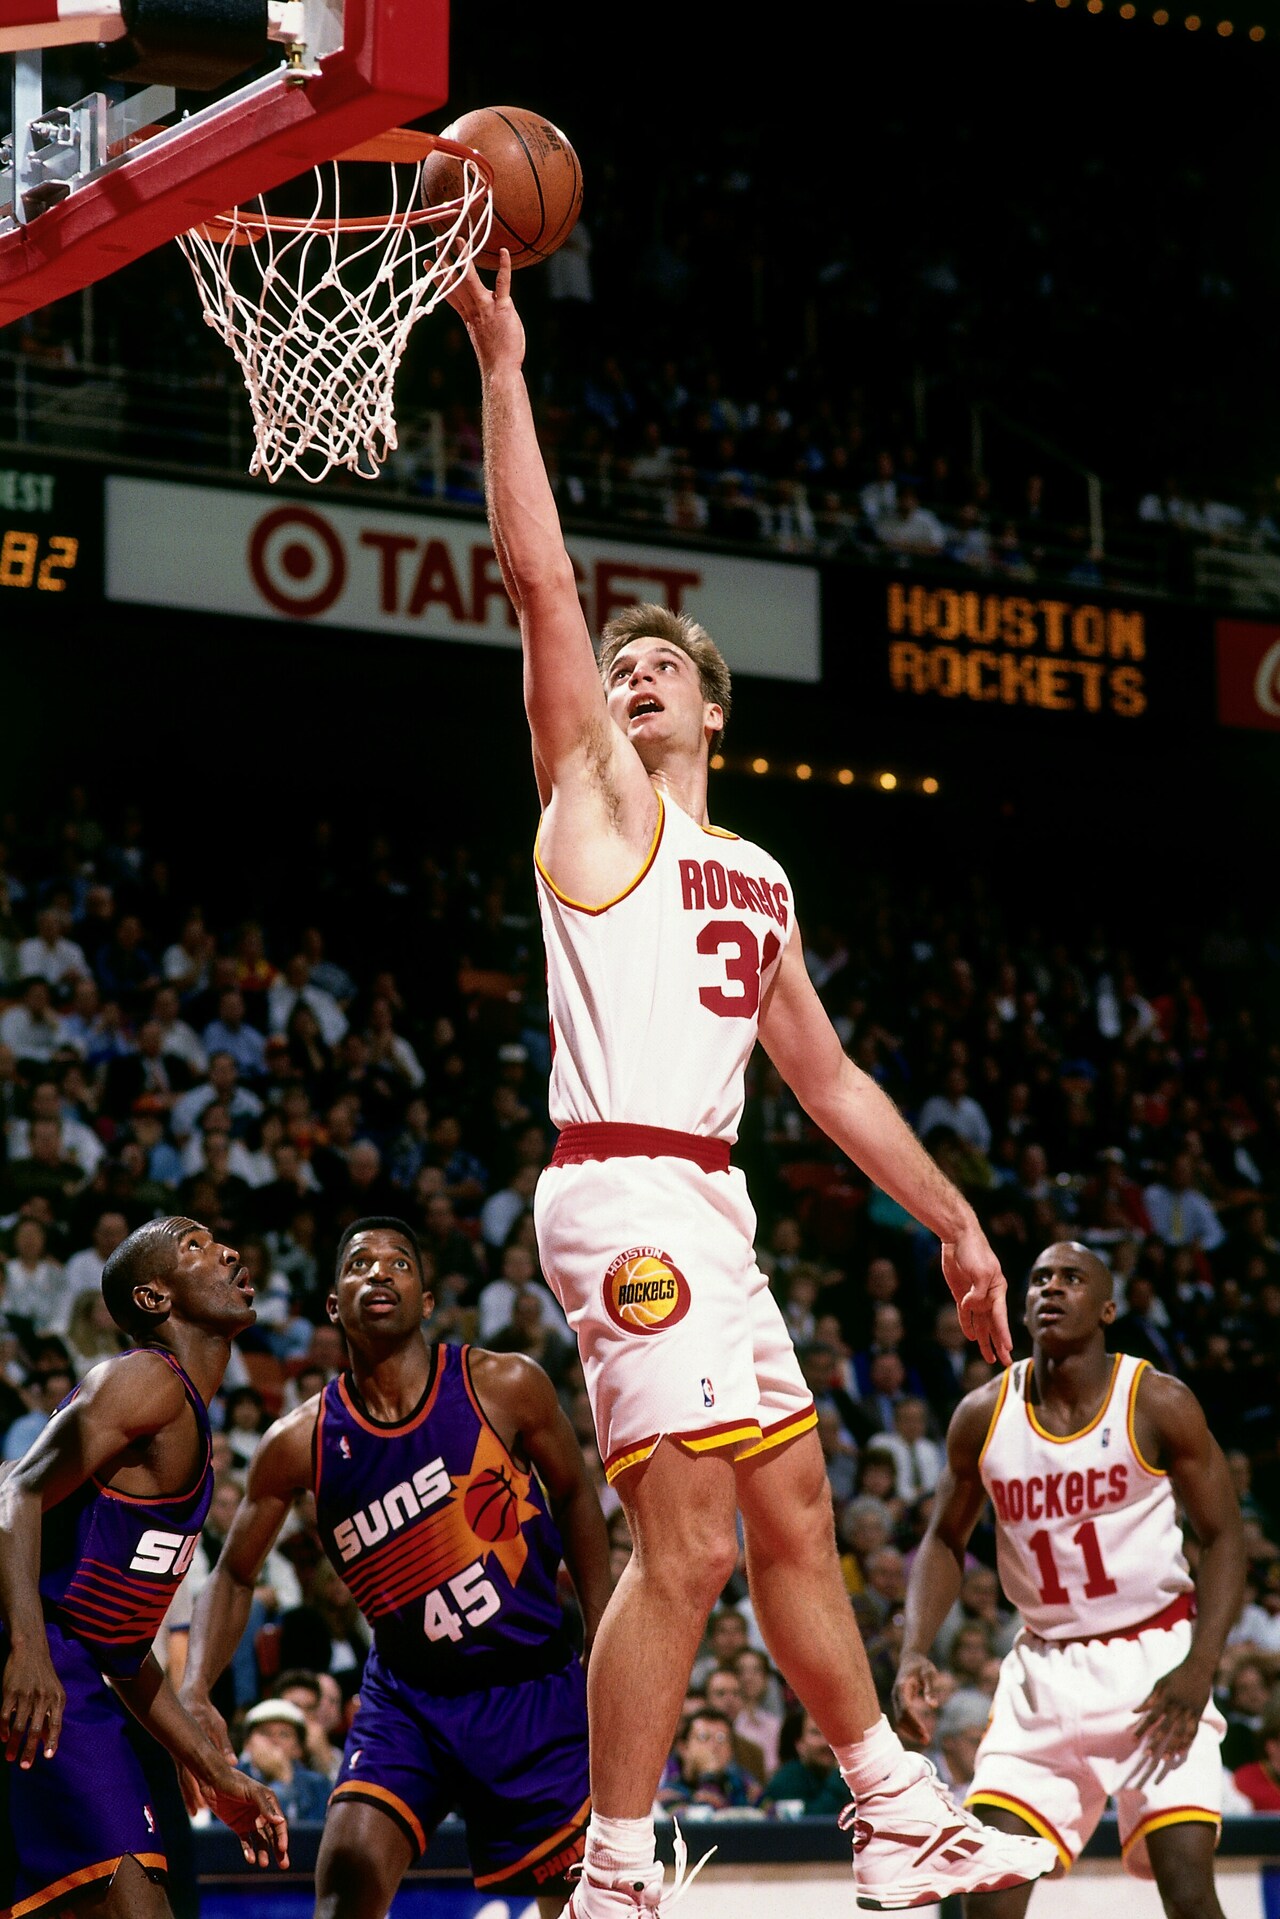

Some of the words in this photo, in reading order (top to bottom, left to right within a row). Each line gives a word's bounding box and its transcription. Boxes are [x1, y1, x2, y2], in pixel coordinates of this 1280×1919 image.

[0, 530, 79, 591] 82
[360, 528, 702, 634] TARET
[886, 580, 1147, 662] HOUSTON
[888, 640, 1149, 718] ROCKETS
[607, 1247, 663, 1276] HOUSTON
[423, 1561, 501, 1642] 45
[1029, 1520, 1117, 1605] 11
